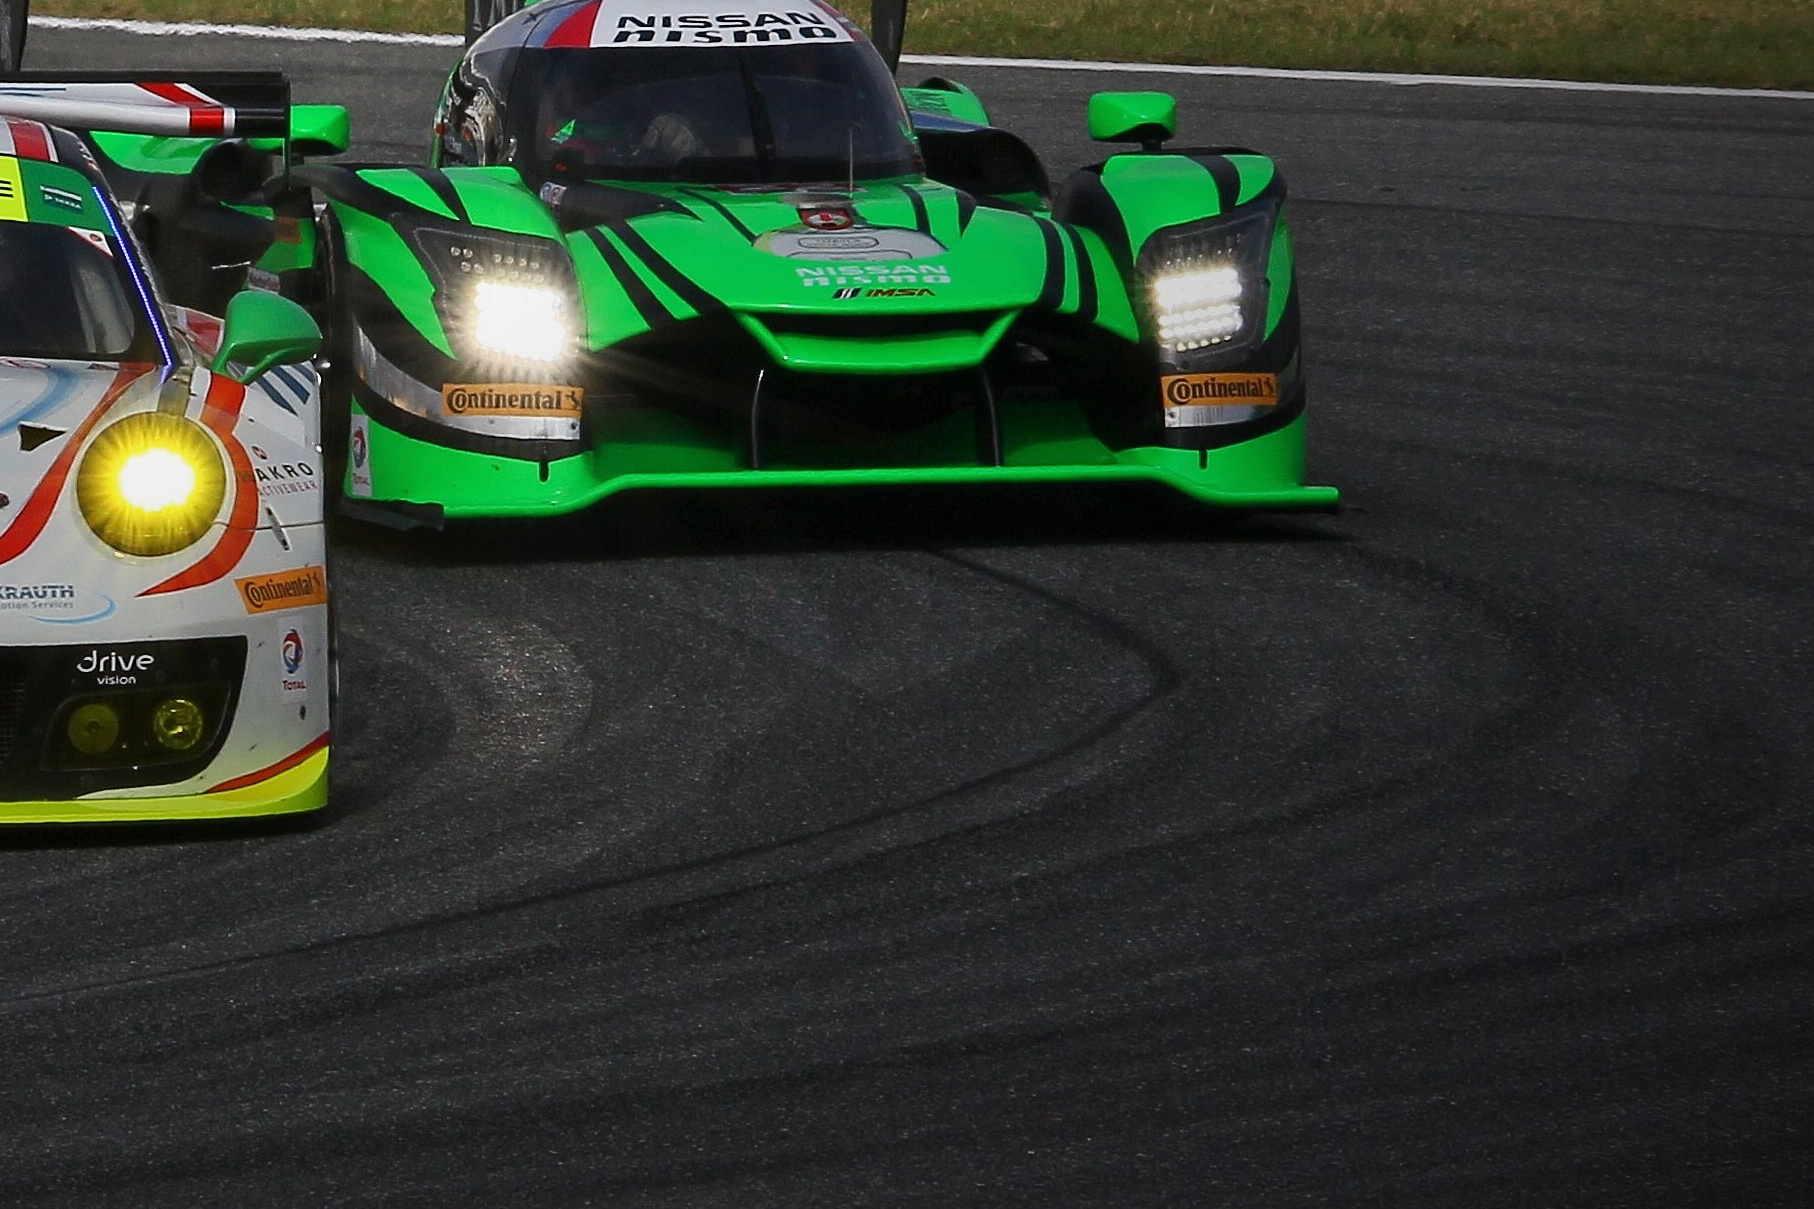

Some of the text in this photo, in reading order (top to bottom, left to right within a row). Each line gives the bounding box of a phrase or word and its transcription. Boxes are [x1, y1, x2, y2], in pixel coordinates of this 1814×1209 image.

[617, 12, 825, 29] NISSAN
[612, 26, 837, 43] nismo
[795, 264, 949, 279] NISSAN
[866, 287, 936, 298] IMSA
[1167, 377, 1263, 405] Continental
[447, 389, 563, 414] Continental
[244, 573, 313, 608] Continental
[76, 649, 155, 673] drive
[96, 674, 137, 685] vision
